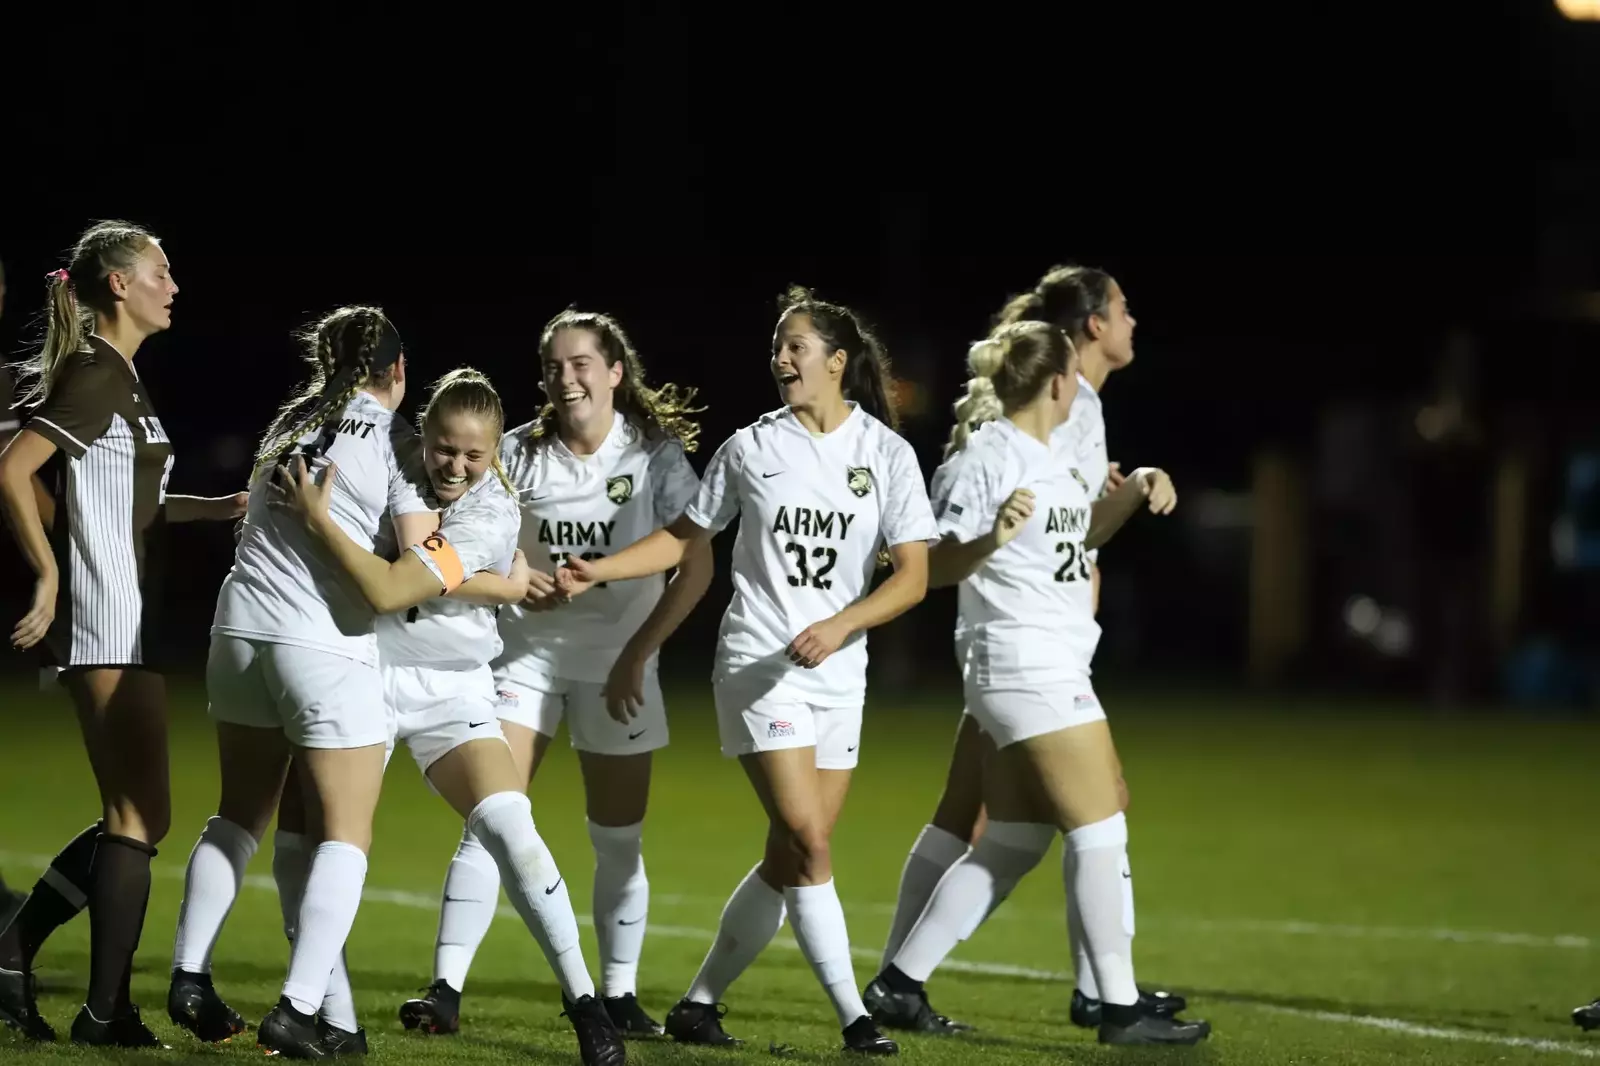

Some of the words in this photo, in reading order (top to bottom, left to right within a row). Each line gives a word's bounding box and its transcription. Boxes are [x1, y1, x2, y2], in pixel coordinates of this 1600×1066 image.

[538, 519, 616, 546] ARMY
[772, 505, 856, 540] ARMY
[1044, 506, 1088, 534] ARMY
[785, 542, 837, 590] 32
